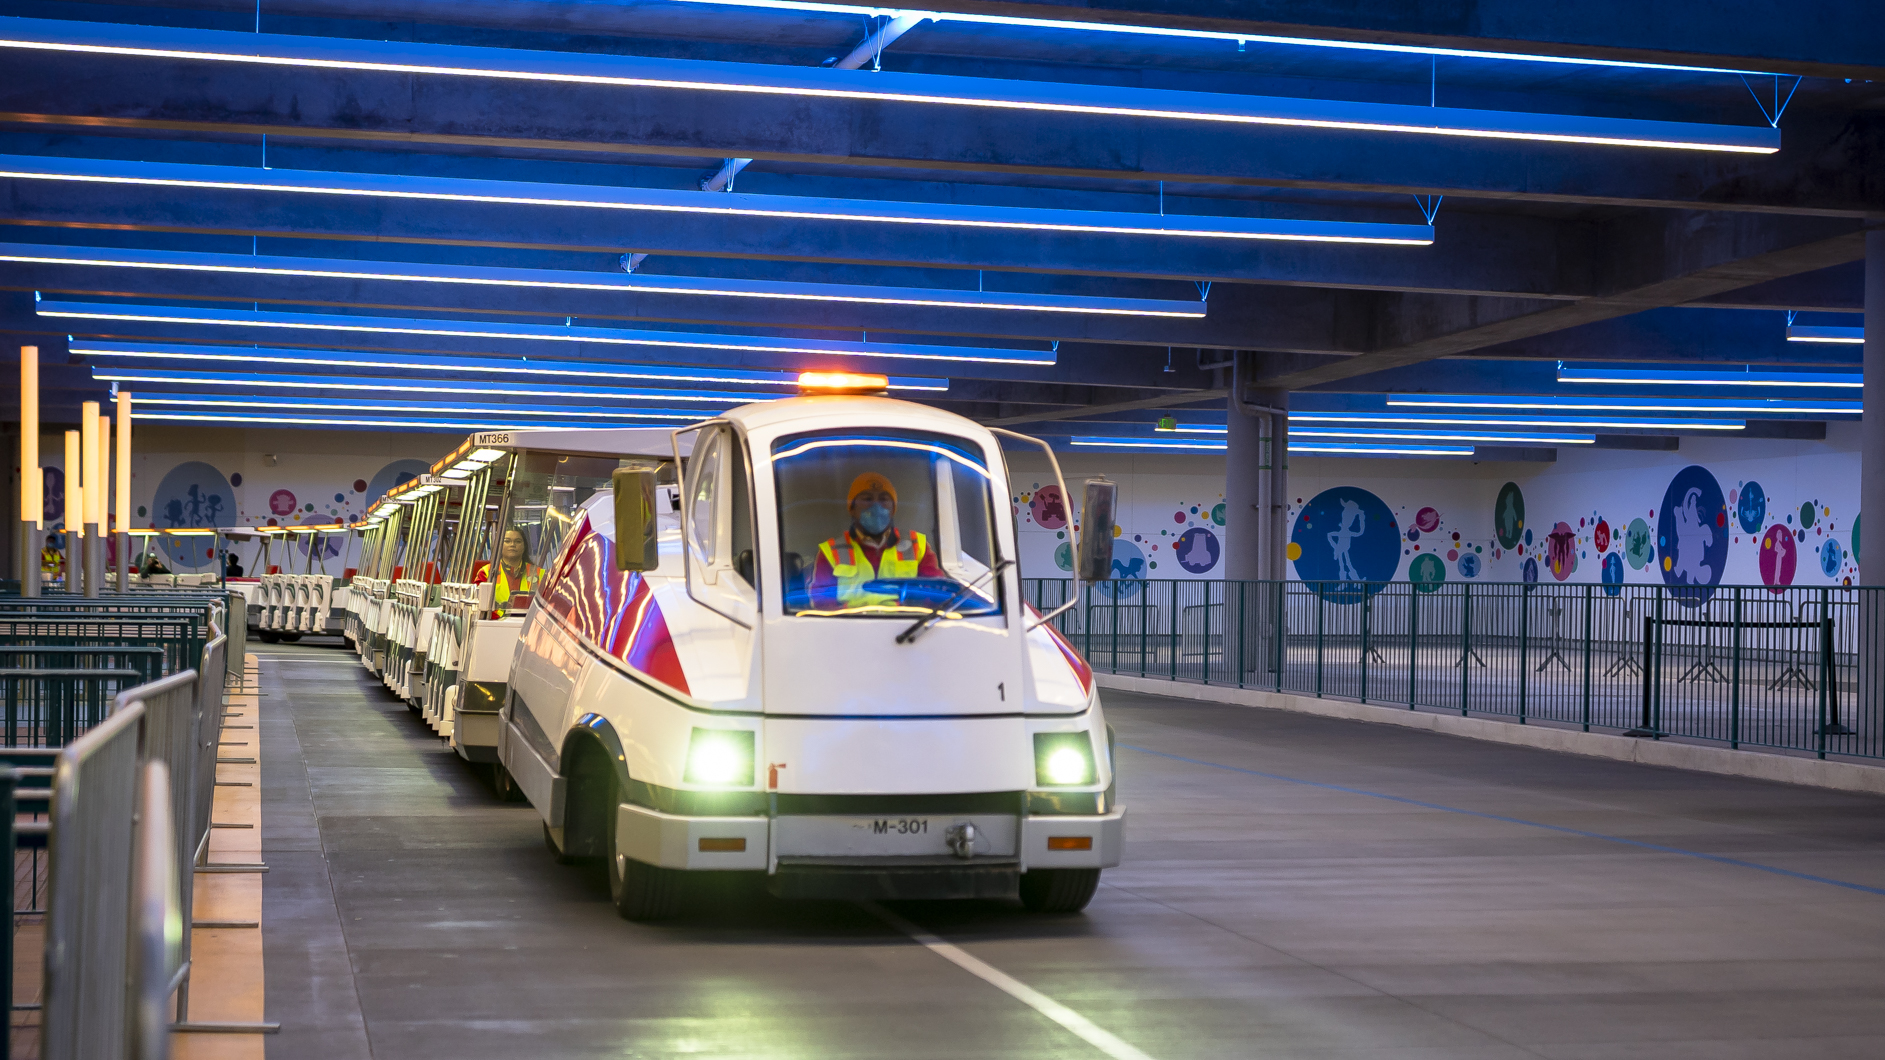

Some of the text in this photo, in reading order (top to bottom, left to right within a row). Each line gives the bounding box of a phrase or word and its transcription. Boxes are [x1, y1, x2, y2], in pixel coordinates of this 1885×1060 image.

[479, 433, 509, 444] MT366
[997, 681, 1006, 702] 1
[873, 819, 928, 835] M-301
